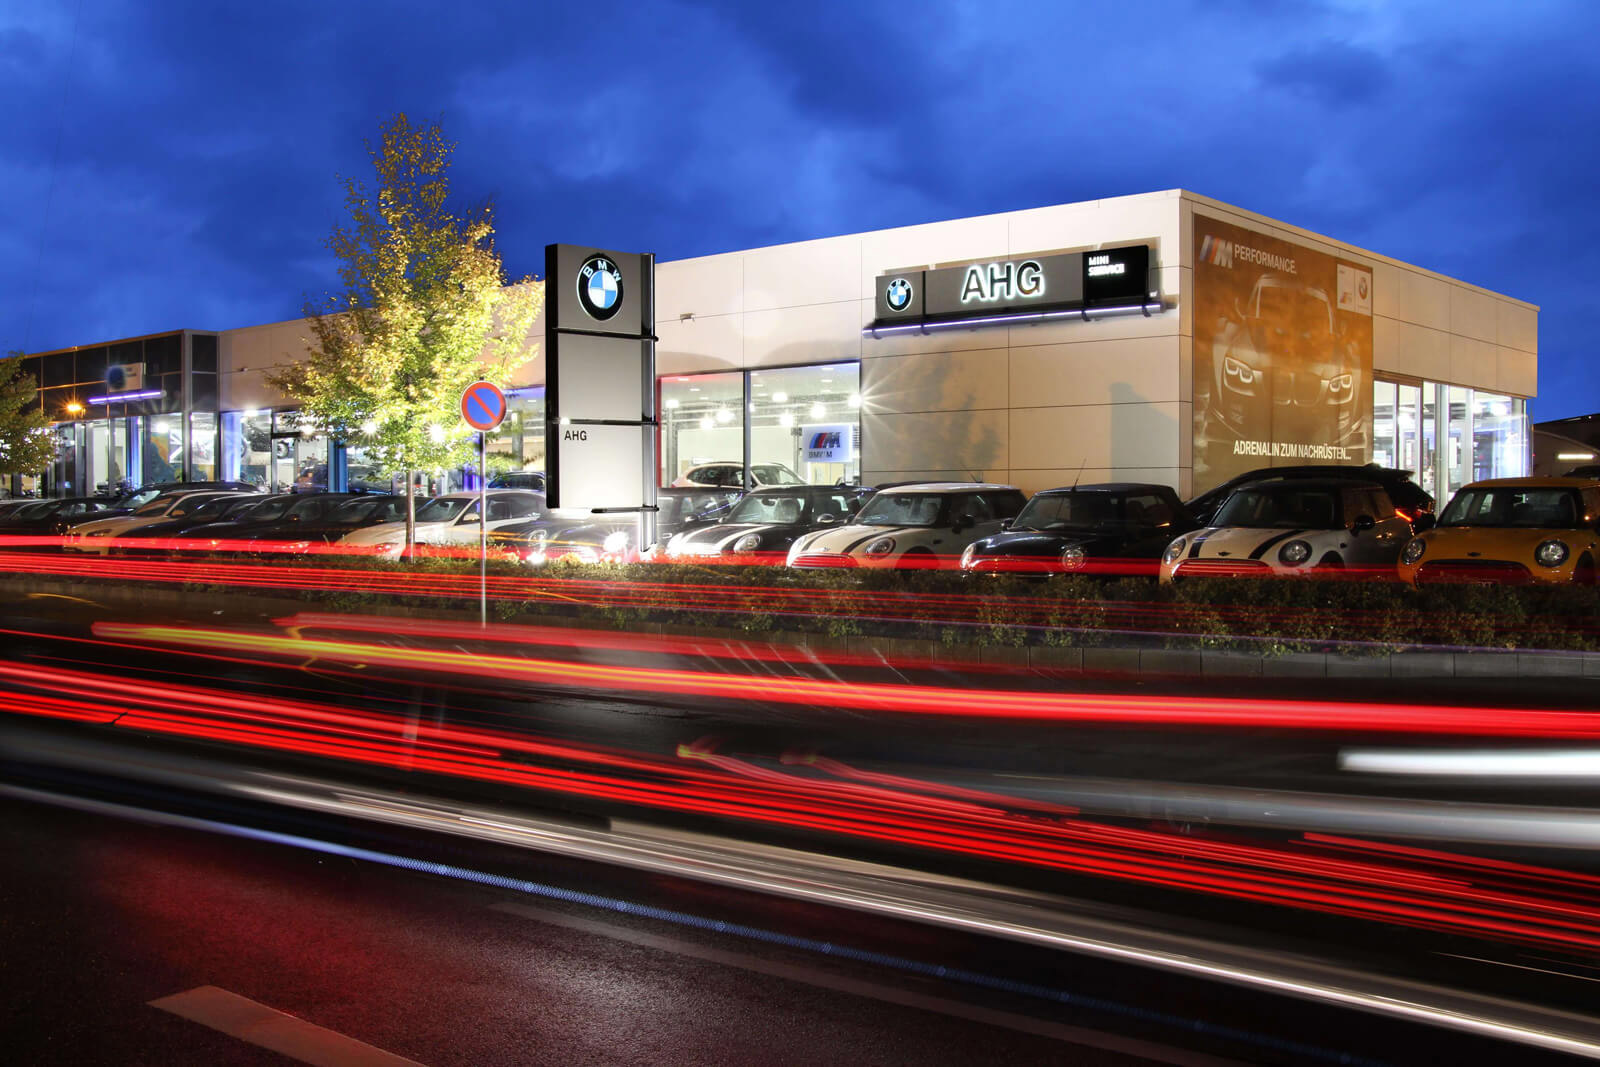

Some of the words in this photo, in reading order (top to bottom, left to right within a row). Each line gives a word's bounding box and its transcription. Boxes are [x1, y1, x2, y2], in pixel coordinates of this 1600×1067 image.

[1089, 255, 1109, 265] MINI
[583, 259, 621, 281] BMW
[961, 261, 1043, 302] AHG
[564, 430, 587, 441] AHG
[1233, 440, 1280, 456] ADRENALIN
[1280, 443, 1297, 457] ZUM
